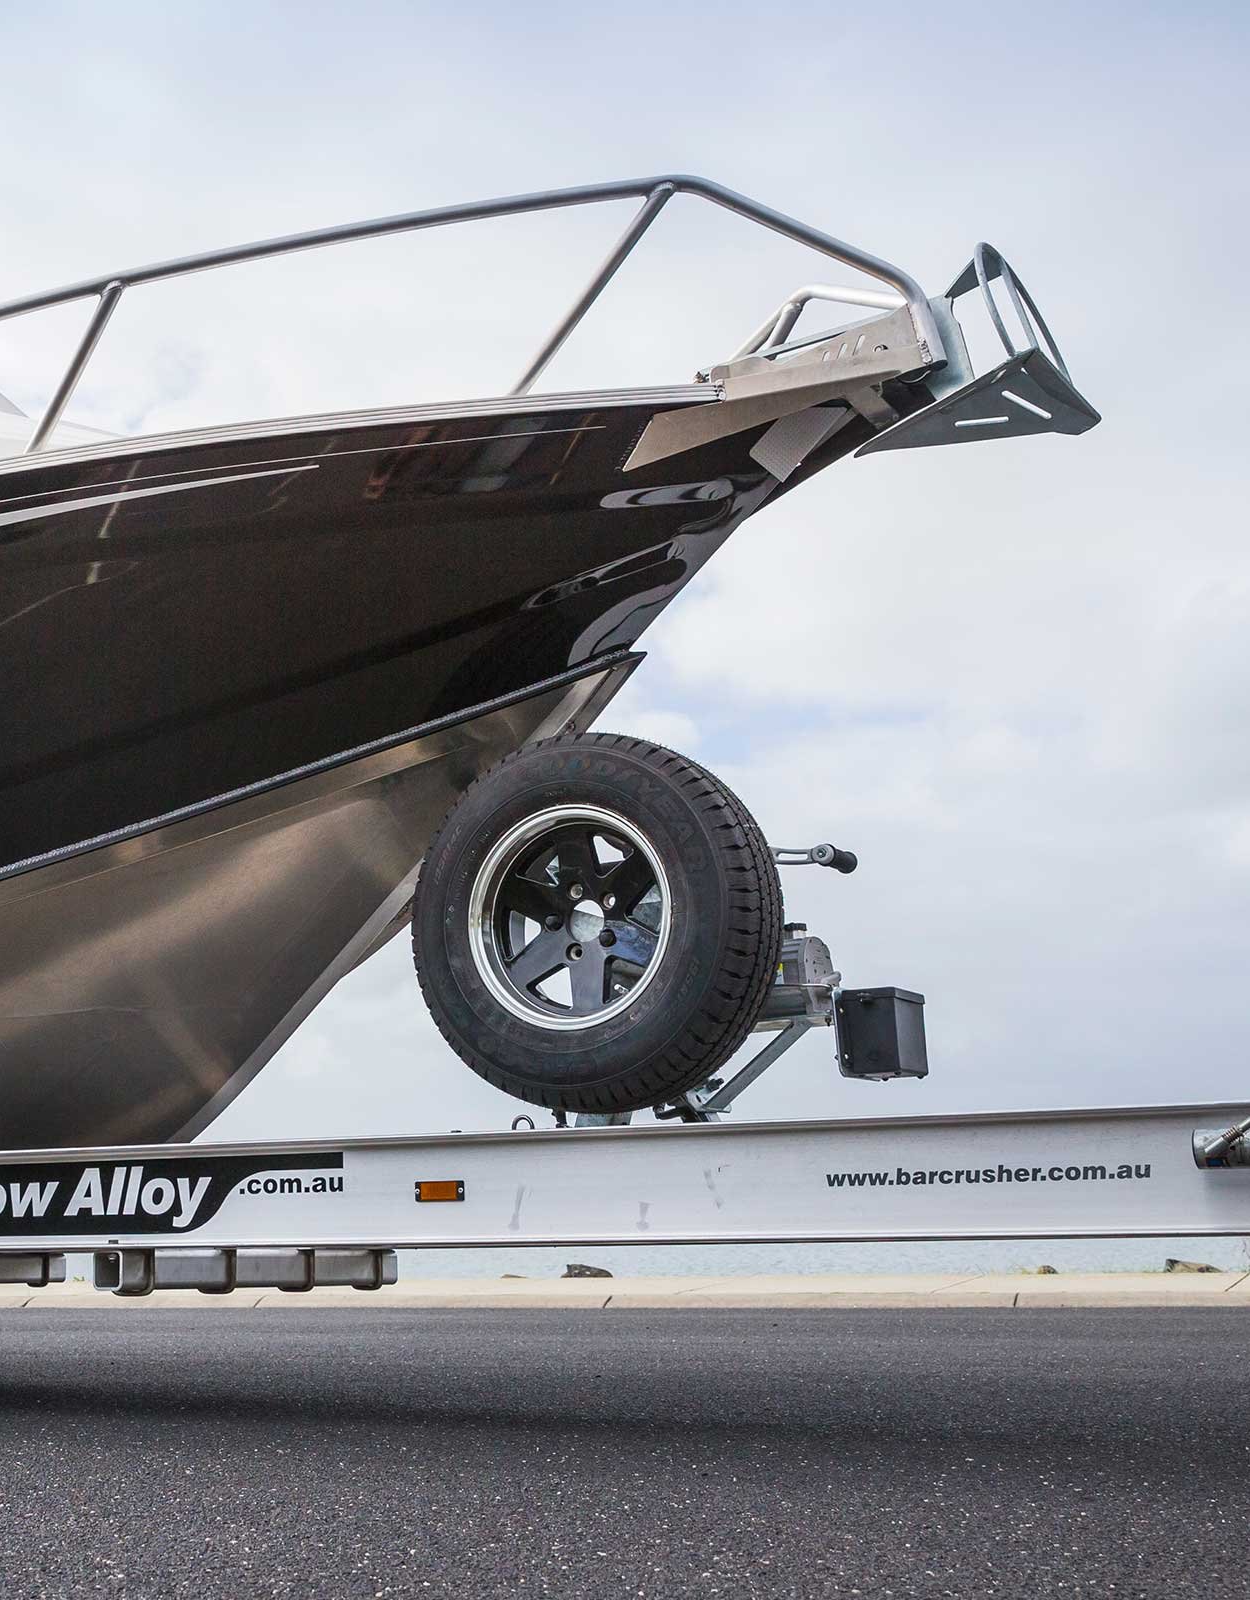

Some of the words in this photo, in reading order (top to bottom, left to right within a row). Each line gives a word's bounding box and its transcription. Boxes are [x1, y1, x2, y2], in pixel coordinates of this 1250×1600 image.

[826, 1164, 1150, 1187] www.barcrusher.com.au
[63, 1166, 212, 1228] Alloy
[239, 1176, 344, 1195] .com.au
